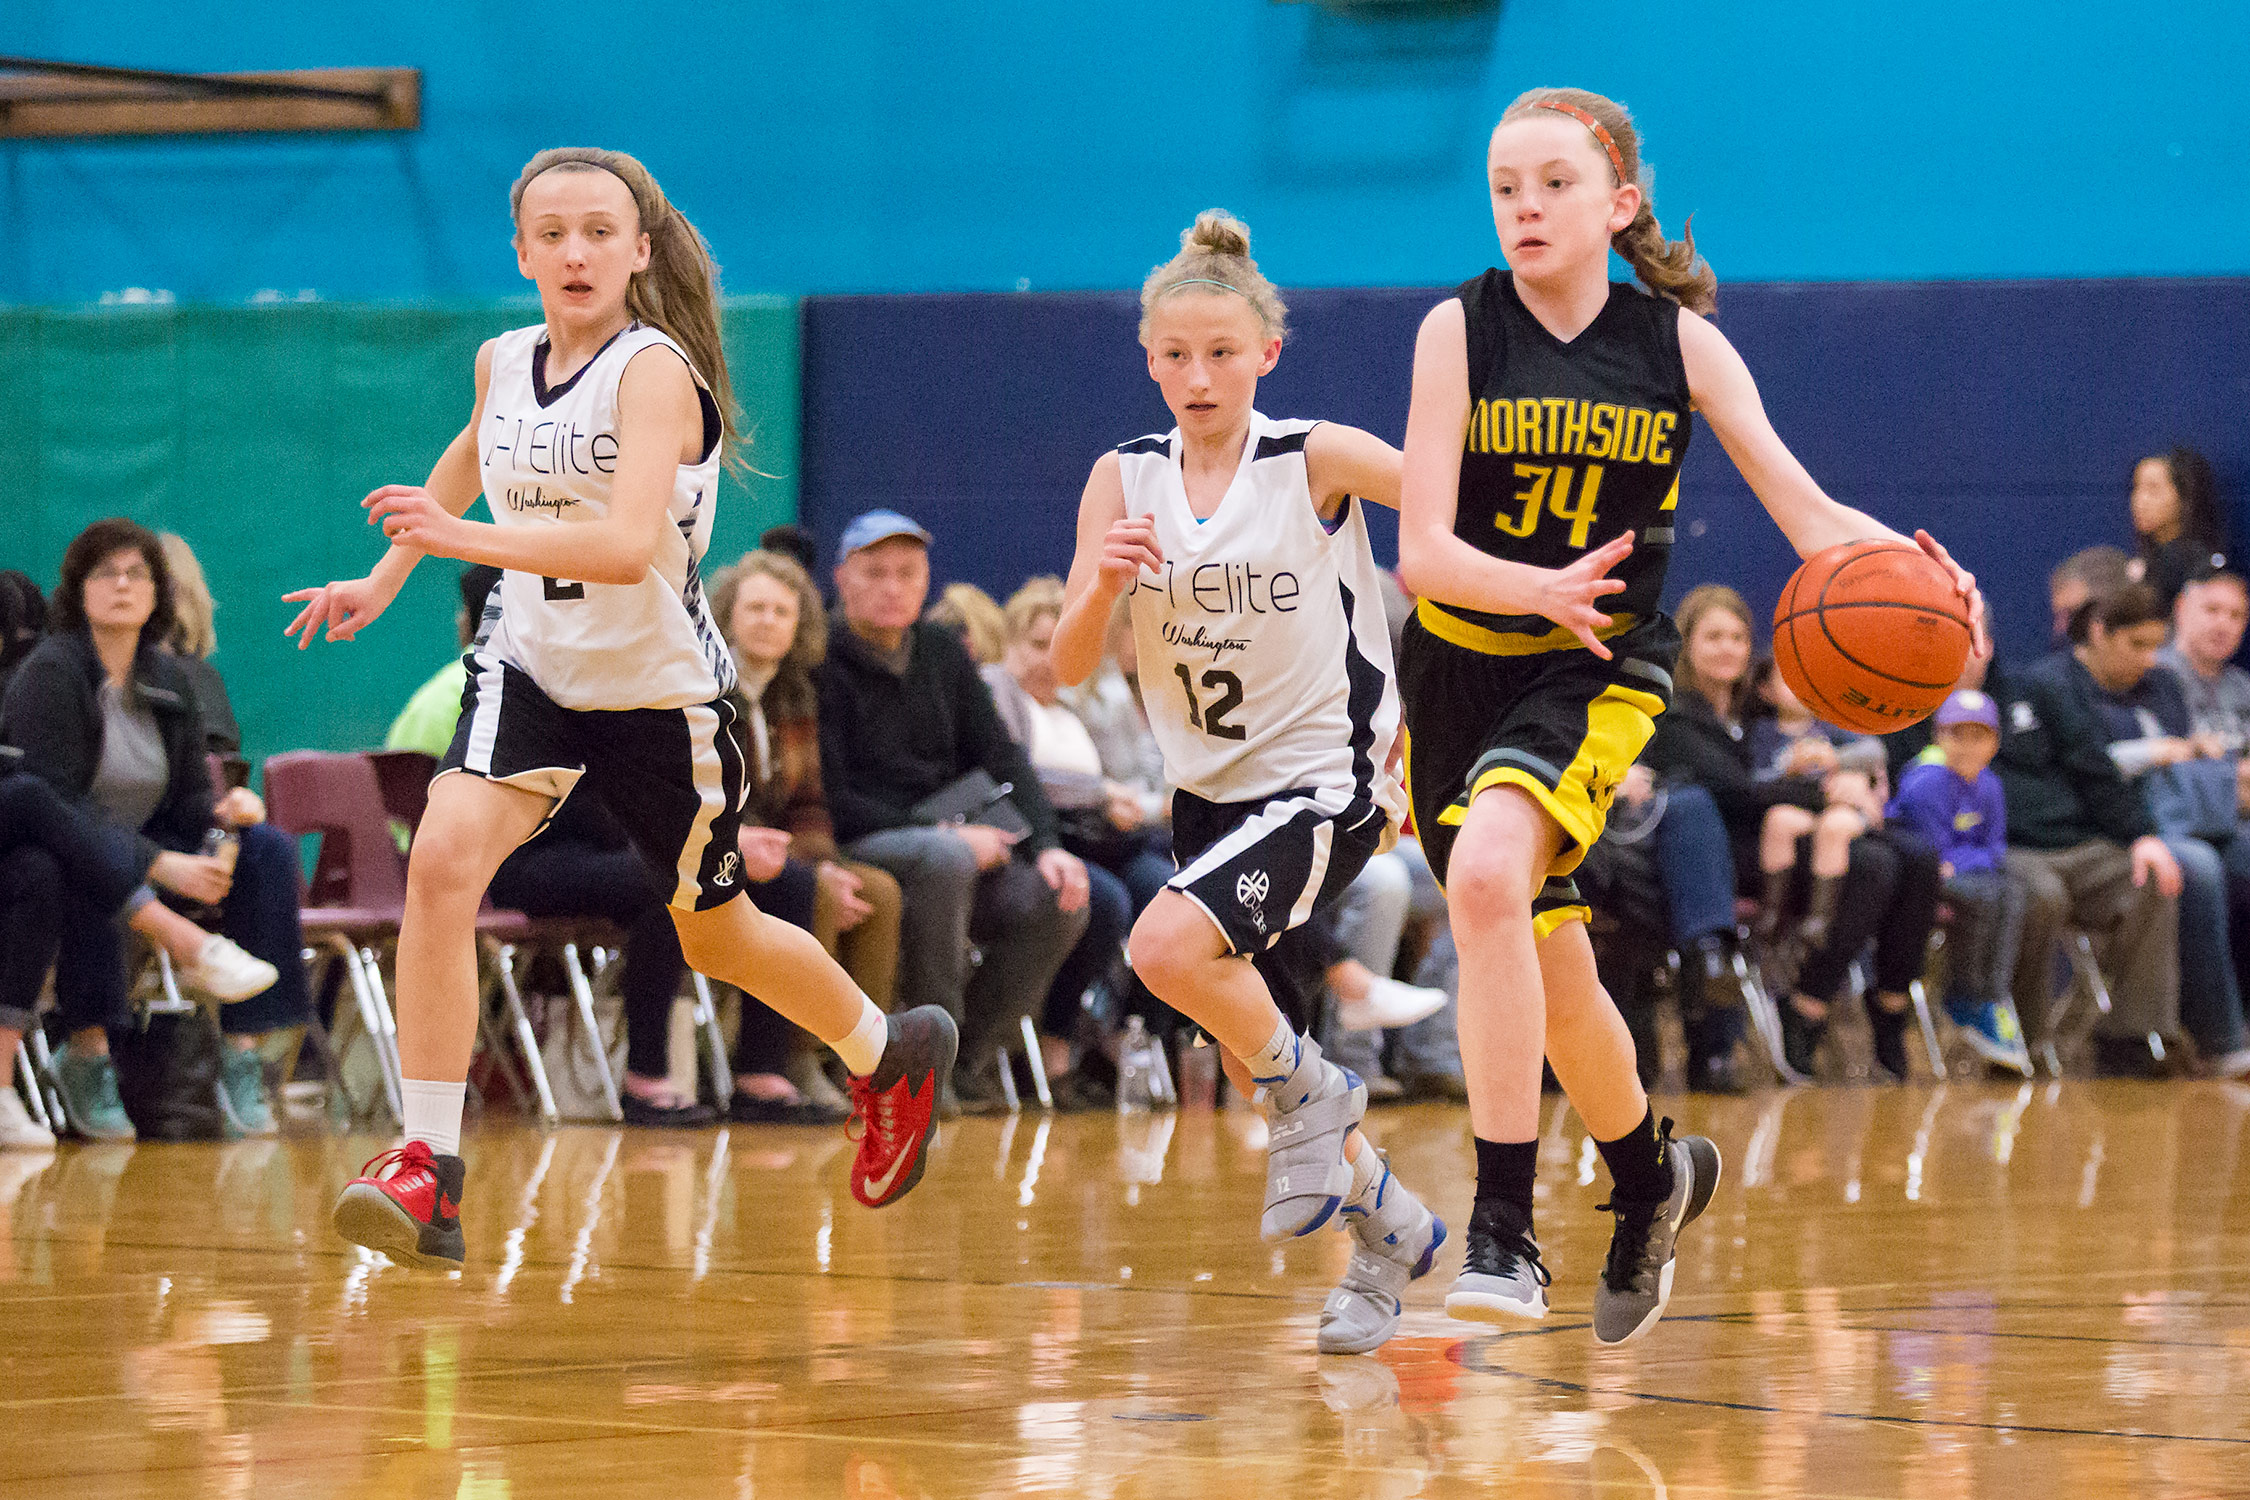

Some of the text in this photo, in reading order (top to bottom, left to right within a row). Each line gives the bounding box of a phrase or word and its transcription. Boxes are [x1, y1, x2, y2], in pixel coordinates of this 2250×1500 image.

[530, 421, 619, 475] Elite
[1469, 398, 1678, 465] NORTHSIDE
[1494, 463, 1604, 549] 34
[1193, 562, 1300, 614] Elite
[1162, 621, 1252, 662] Washington
[1174, 662, 1247, 741] 12
